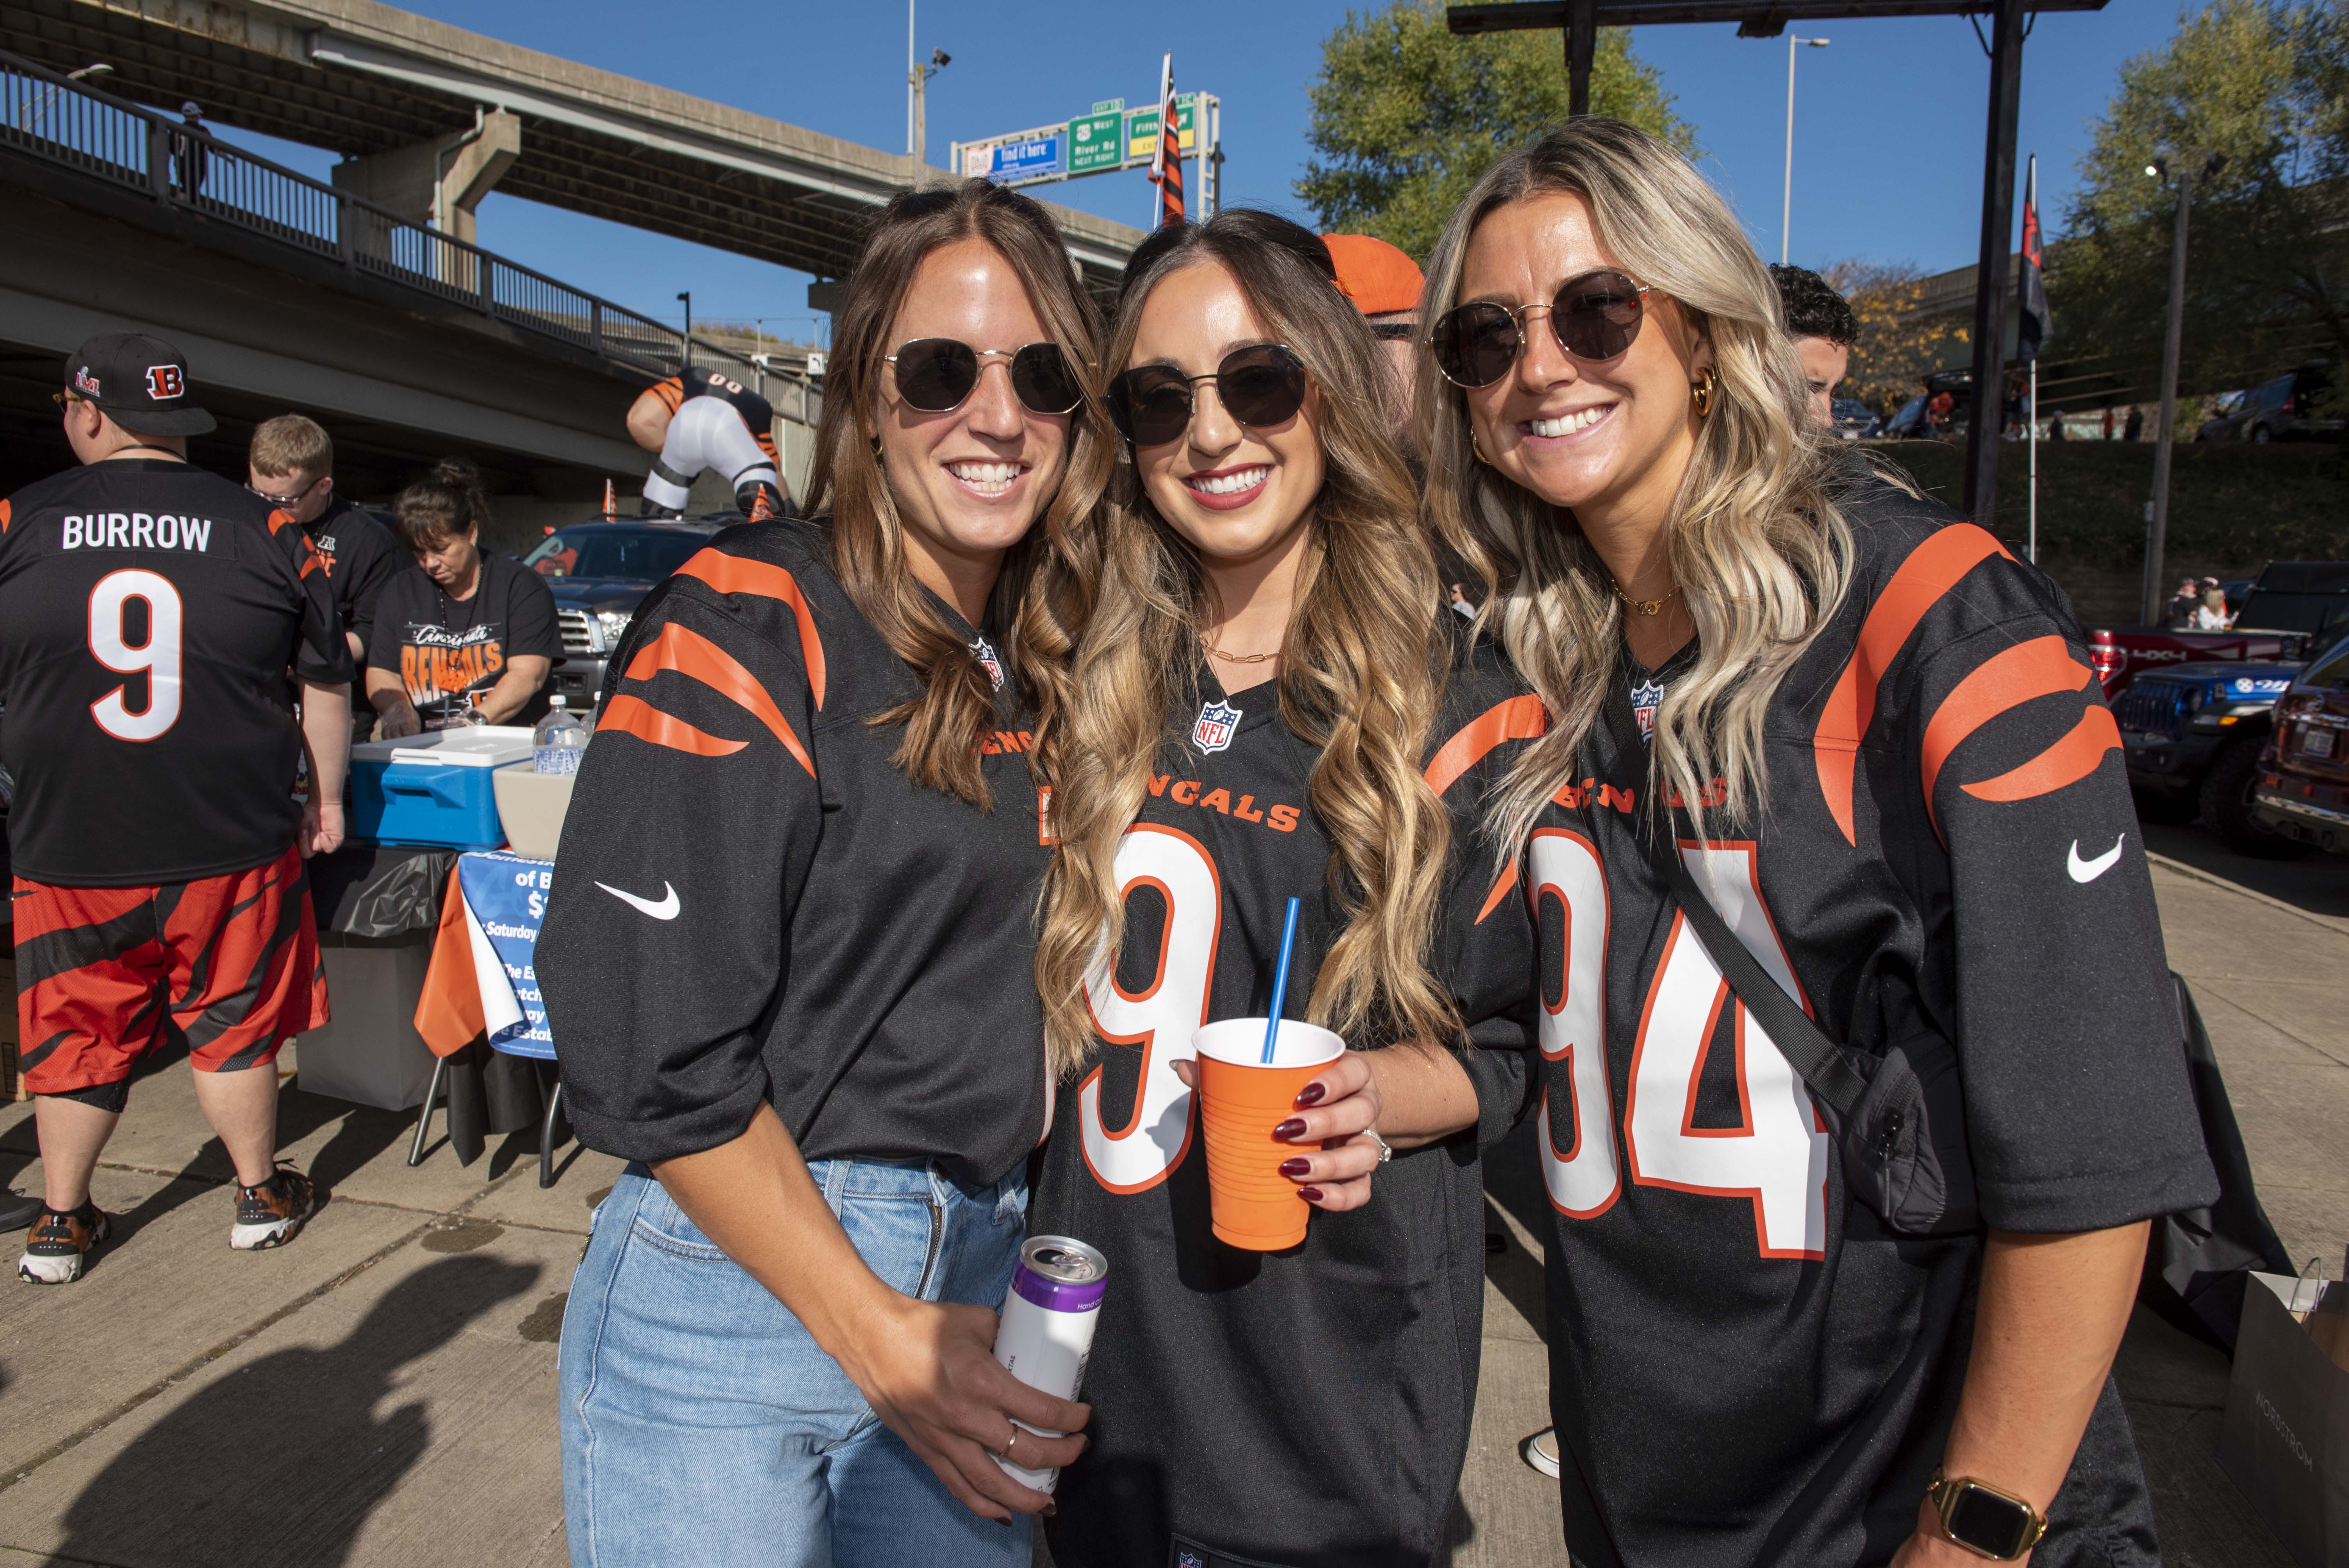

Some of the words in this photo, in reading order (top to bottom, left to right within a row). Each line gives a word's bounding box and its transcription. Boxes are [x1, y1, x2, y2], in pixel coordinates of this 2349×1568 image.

[1136, 122, 1159, 134] Fifth
[1001, 146, 1018, 162] find
[1075, 145, 1099, 156] River
[1103, 141, 1115, 151] Rd
[1075, 157, 1092, 166] NEXT
[1094, 153, 1114, 163] RIGHT
[146, 365, 184, 400] B
[62, 513, 212, 552] BURROW
[87, 568, 183, 743] 9
[1197, 720, 1225, 745] NFL
[1148, 772, 1301, 832] NGALS
[515, 870, 536, 887] of
[539, 872, 552, 889] B
[486, 921, 536, 943] Saturday
[1078, 822, 1221, 1195] 9
[1528, 827, 1829, 1261] 94
[1077, 1300, 1095, 1310] Hand
[1008, 1355, 1016, 1372] KTAIL
[2256, 1391, 2312, 1472] NORDSTROM
